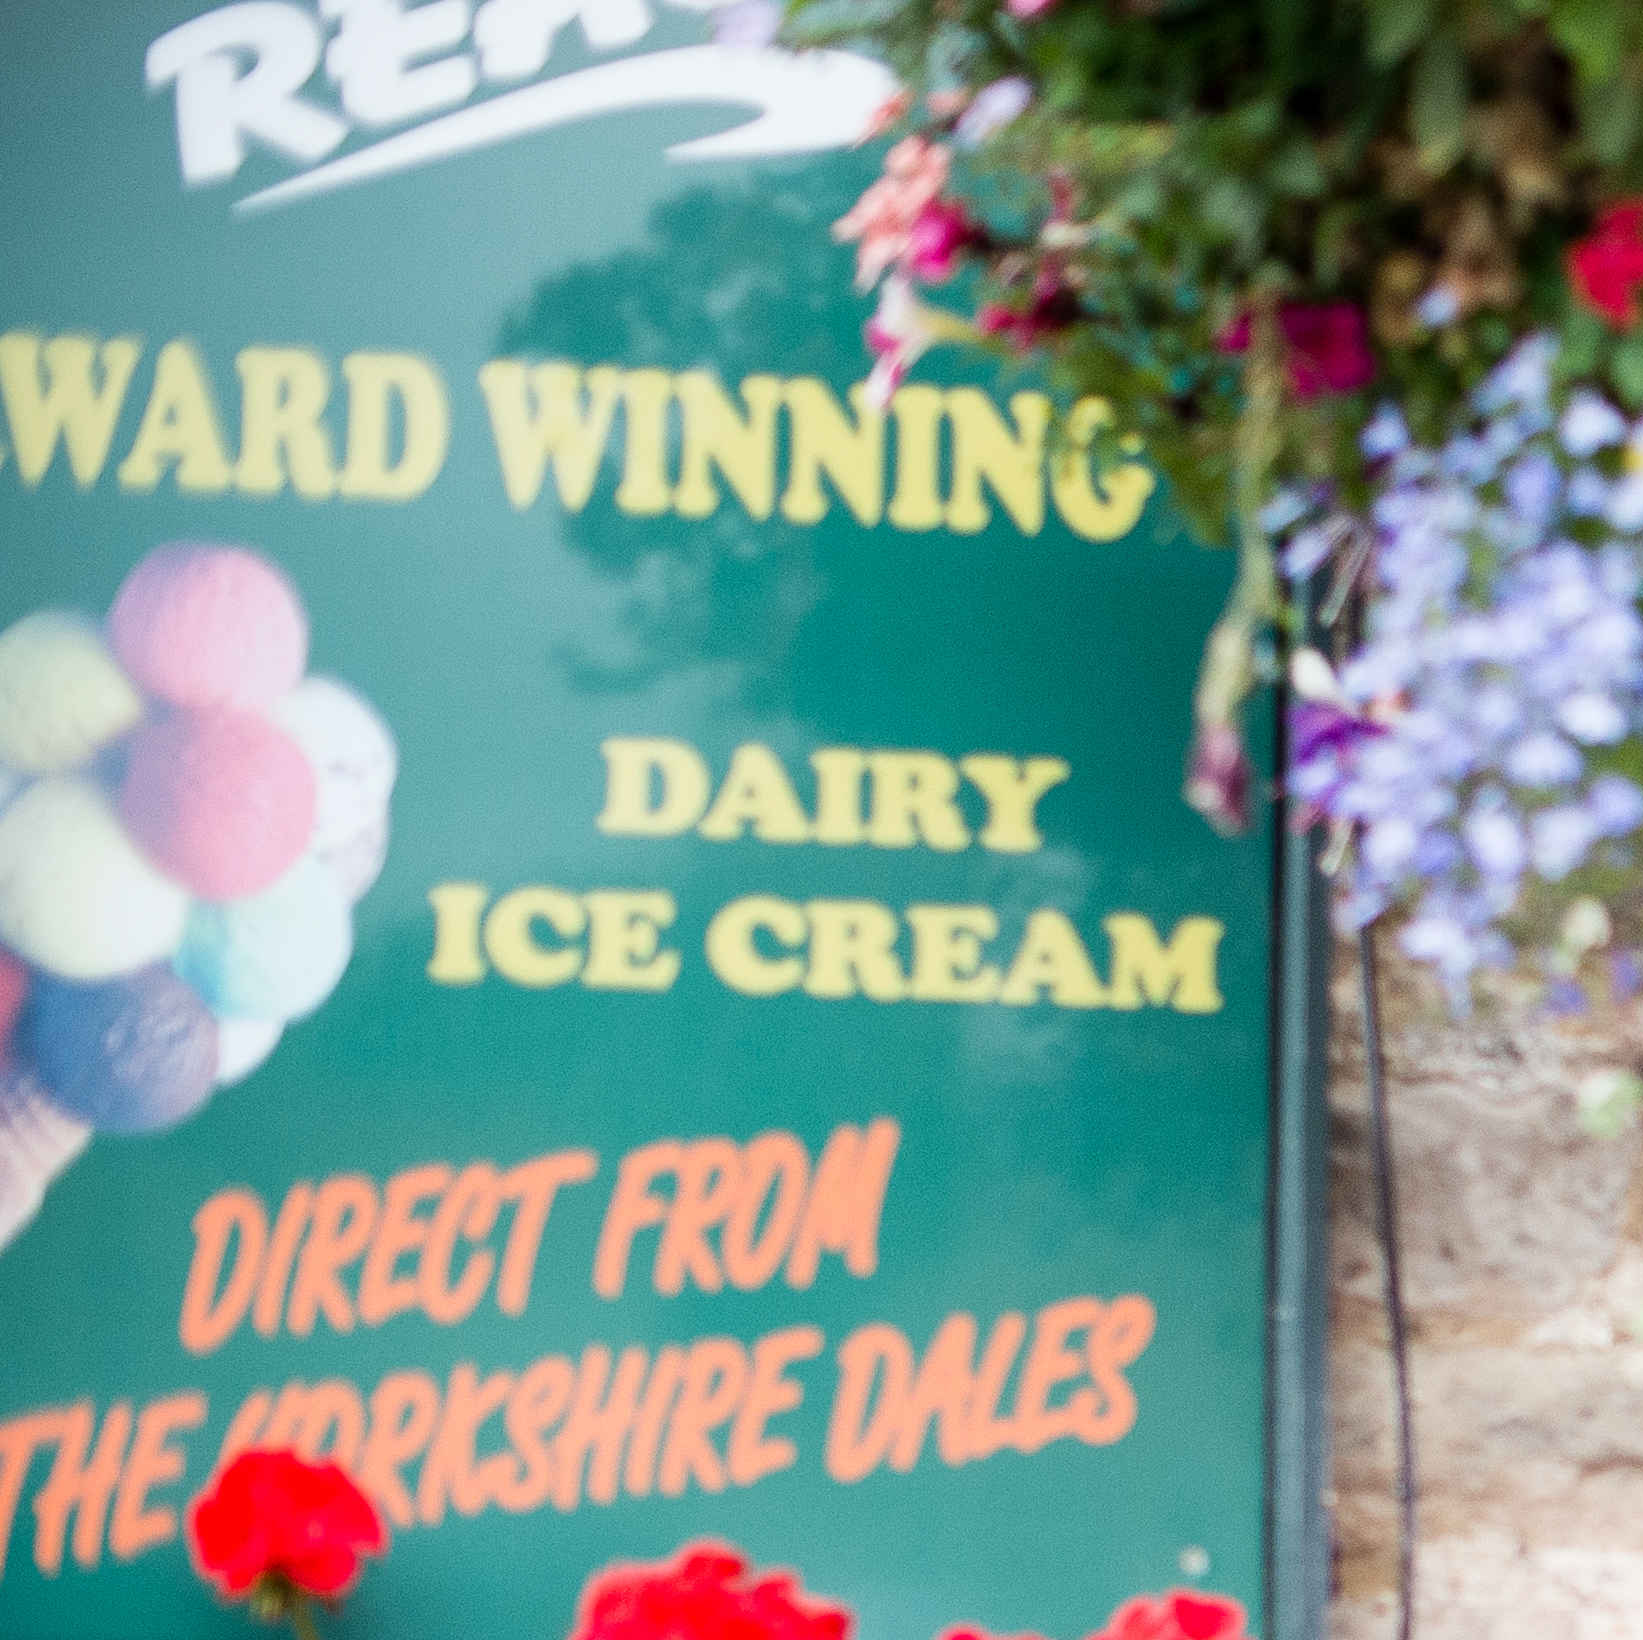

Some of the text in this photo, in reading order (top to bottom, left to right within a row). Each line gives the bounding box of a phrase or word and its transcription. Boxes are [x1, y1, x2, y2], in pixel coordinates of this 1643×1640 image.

[0, 328, 1157, 545] WARD WINNING
[597, 736, 1070, 853] DAIRY
[428, 882, 1225, 1013] ICE CREAM
[180, 1117, 902, 1355] DIRECT FROM
[0, 1390, 208, 1580] THE
[824, 1293, 1156, 1484] DALES
